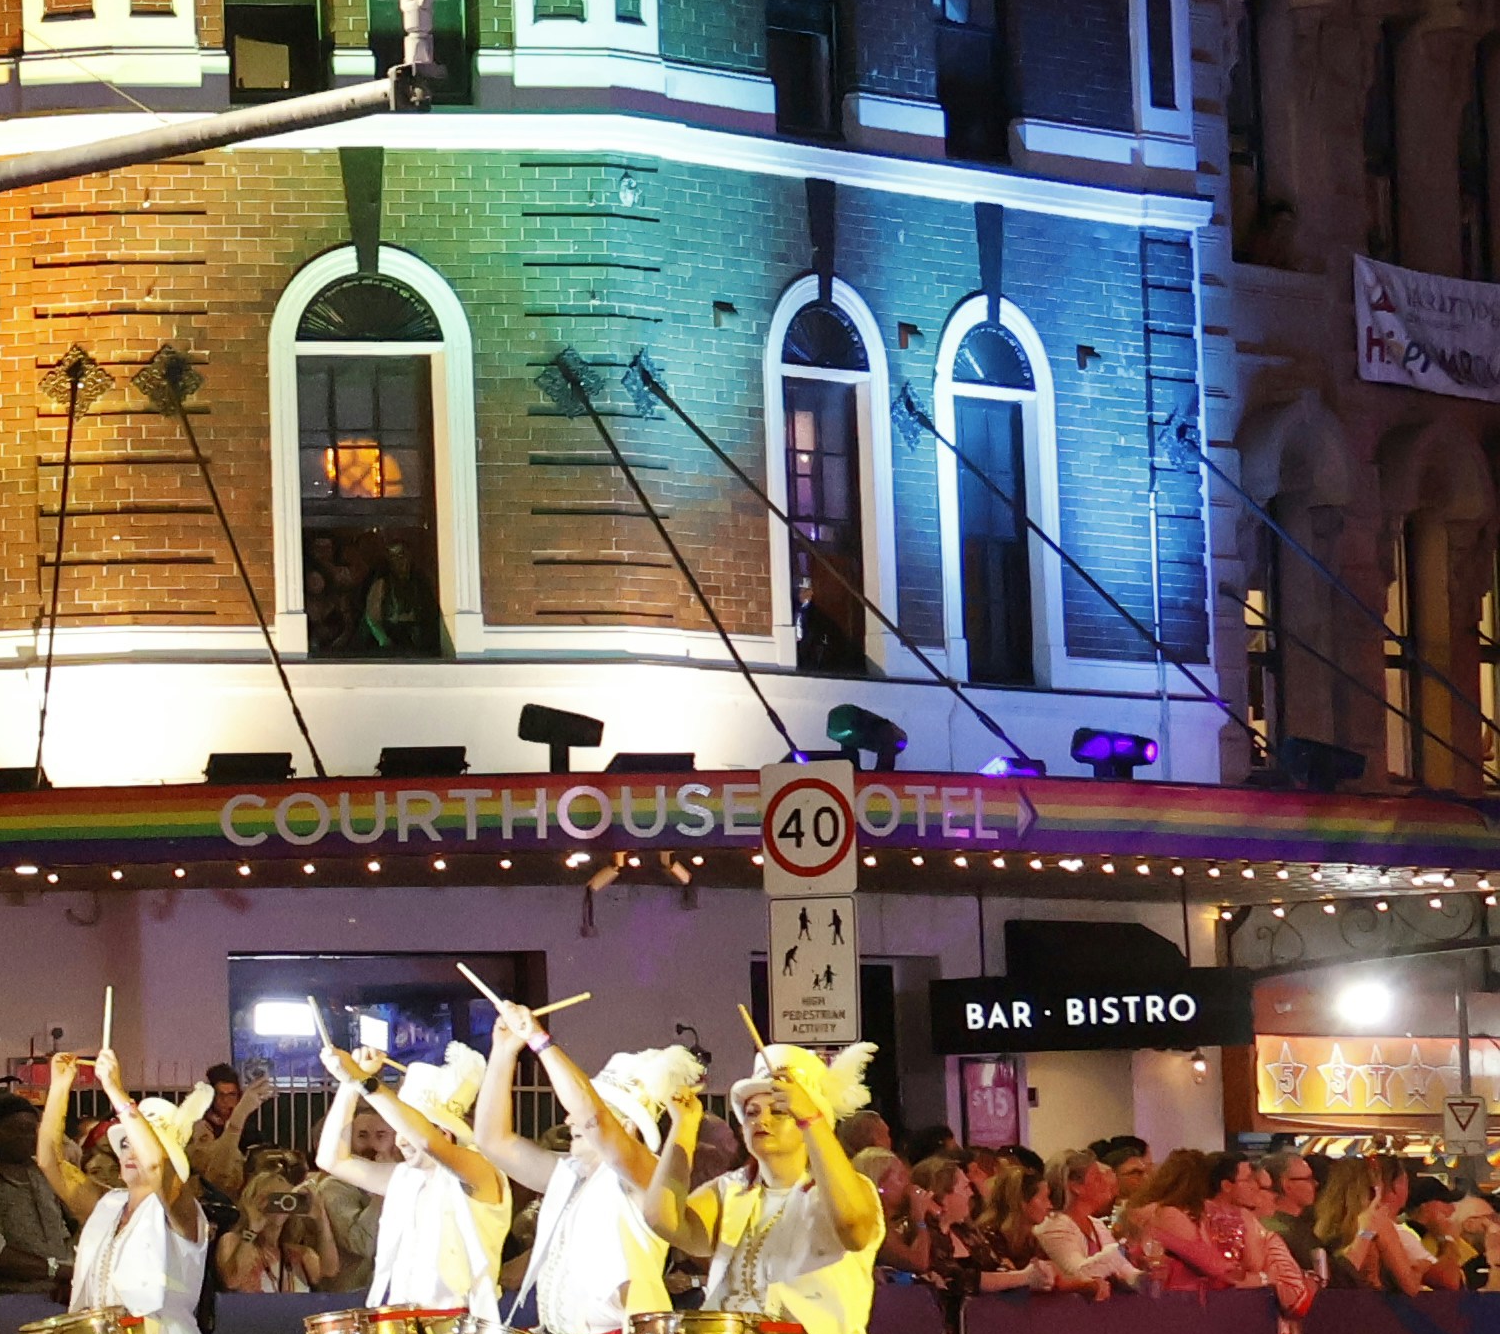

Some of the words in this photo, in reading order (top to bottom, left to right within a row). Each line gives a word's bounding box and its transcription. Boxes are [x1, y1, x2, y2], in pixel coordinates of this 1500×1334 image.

[219, 782, 762, 847] COURTHOUSE
[856, 783, 1000, 840] OTEL
[776, 805, 840, 849] 40
[782, 1010, 846, 1021] PEDESTRIAN
[792, 1024, 837, 1034] ACTIVITY
[965, 1002, 1032, 1031] BAR
[1065, 993, 1198, 1027] BISTRO
